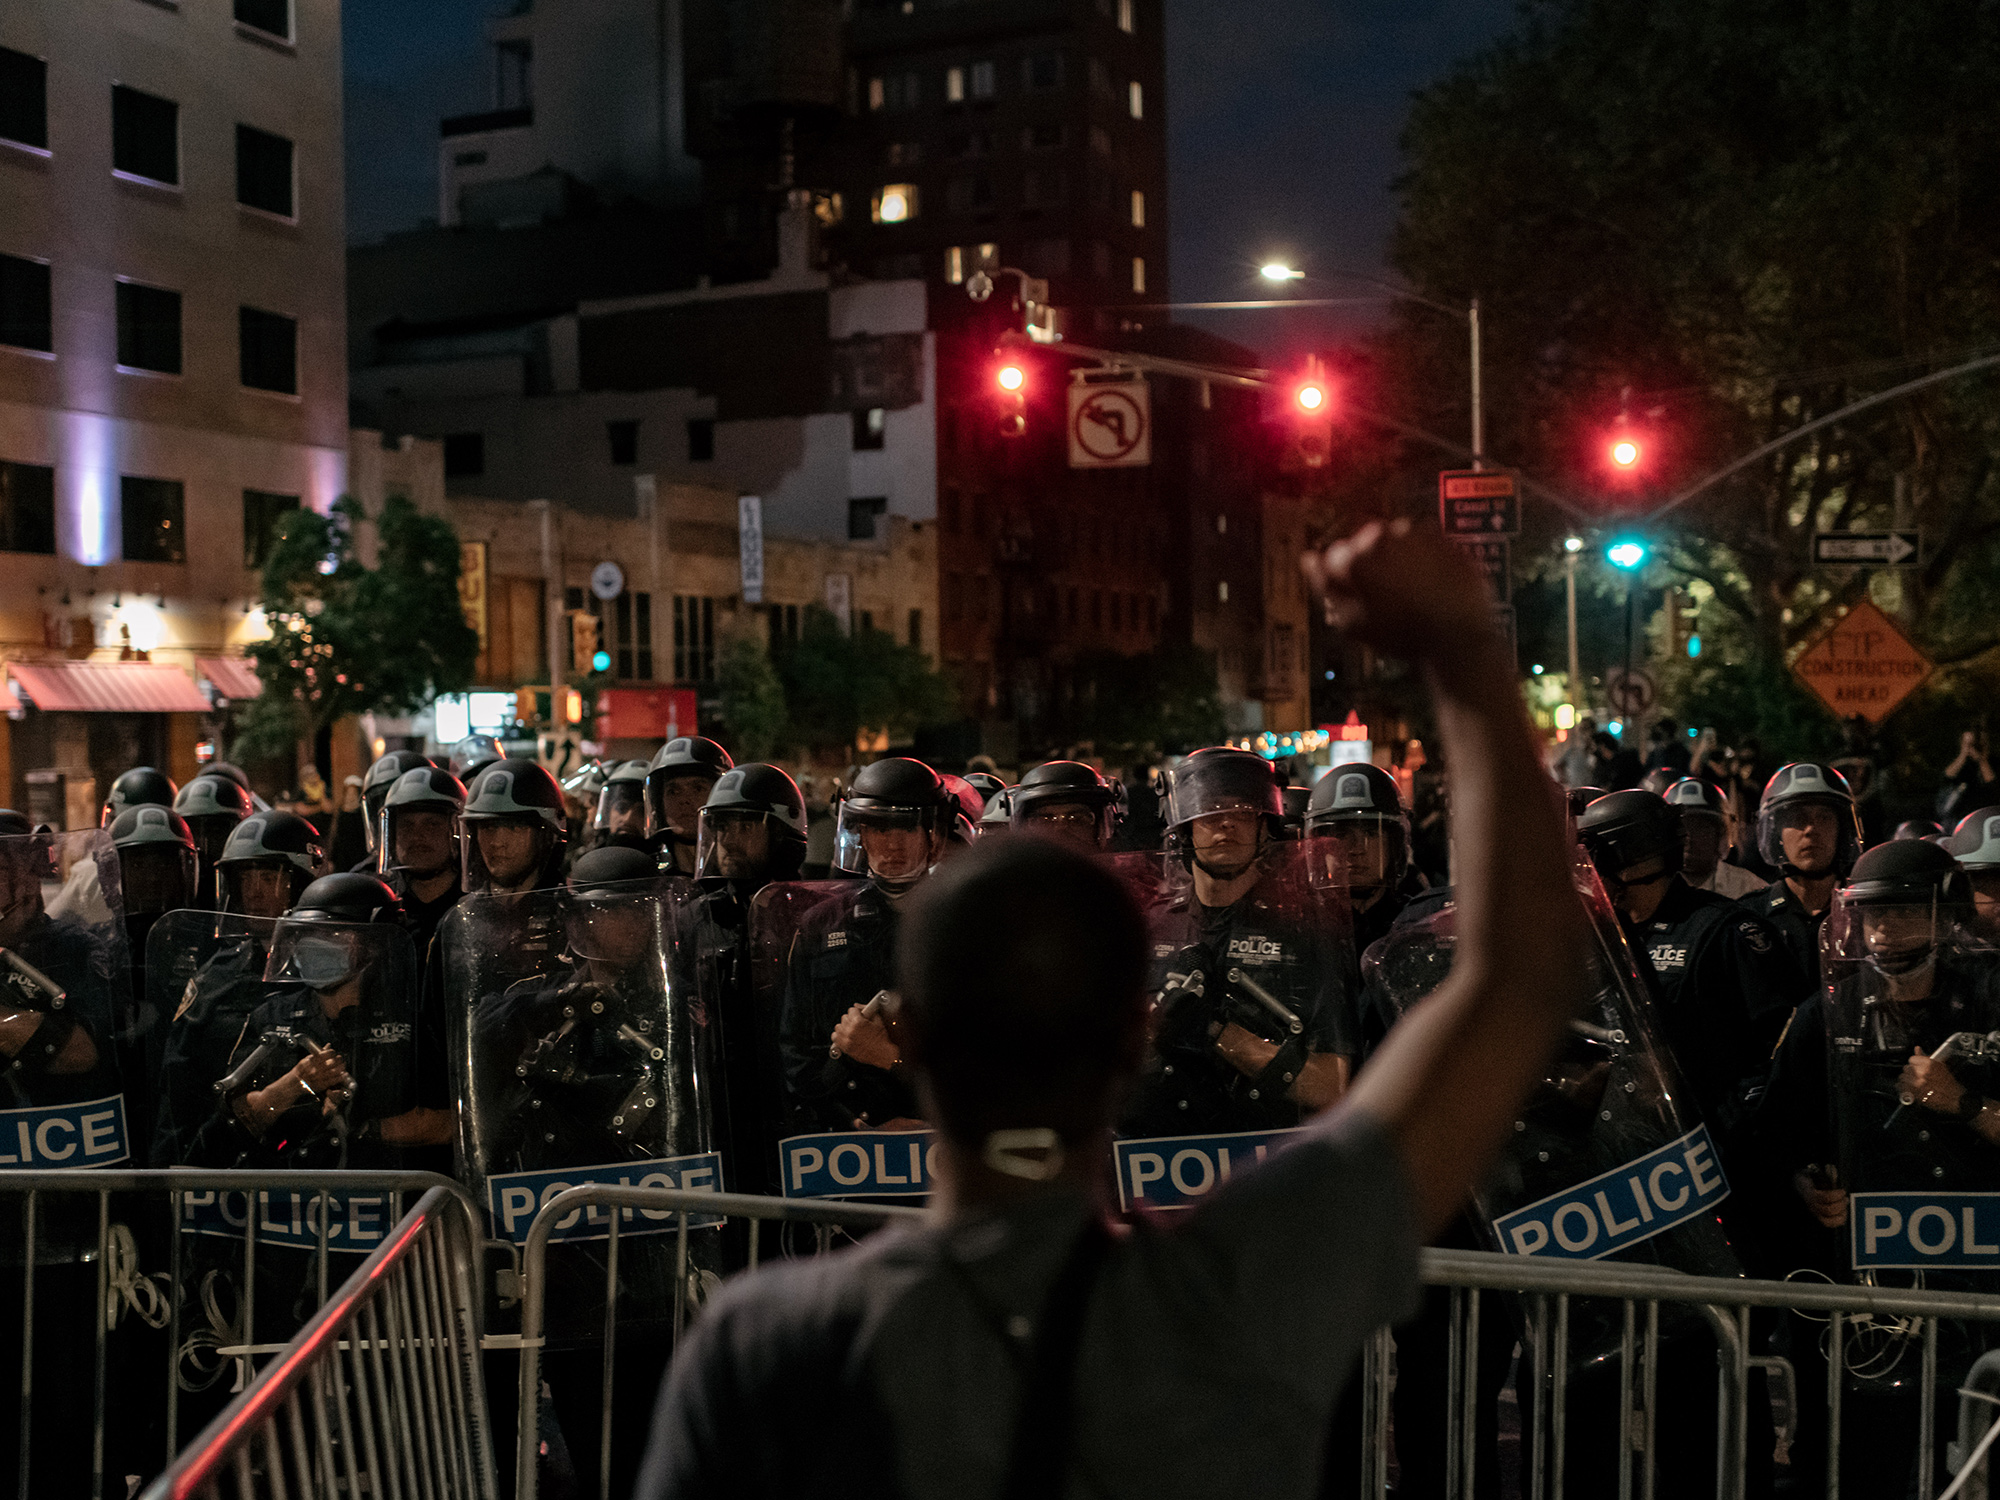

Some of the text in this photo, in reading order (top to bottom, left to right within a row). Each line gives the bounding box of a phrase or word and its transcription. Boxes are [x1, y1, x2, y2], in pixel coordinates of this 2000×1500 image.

[1804, 659, 1924, 677] CONSTRUCTION
[1836, 685, 1889, 700] AHEAD
[1229, 939, 1282, 954] POLICE
[1510, 1140, 1722, 1256] POLICE
[1864, 1205, 2000, 1255] POL
